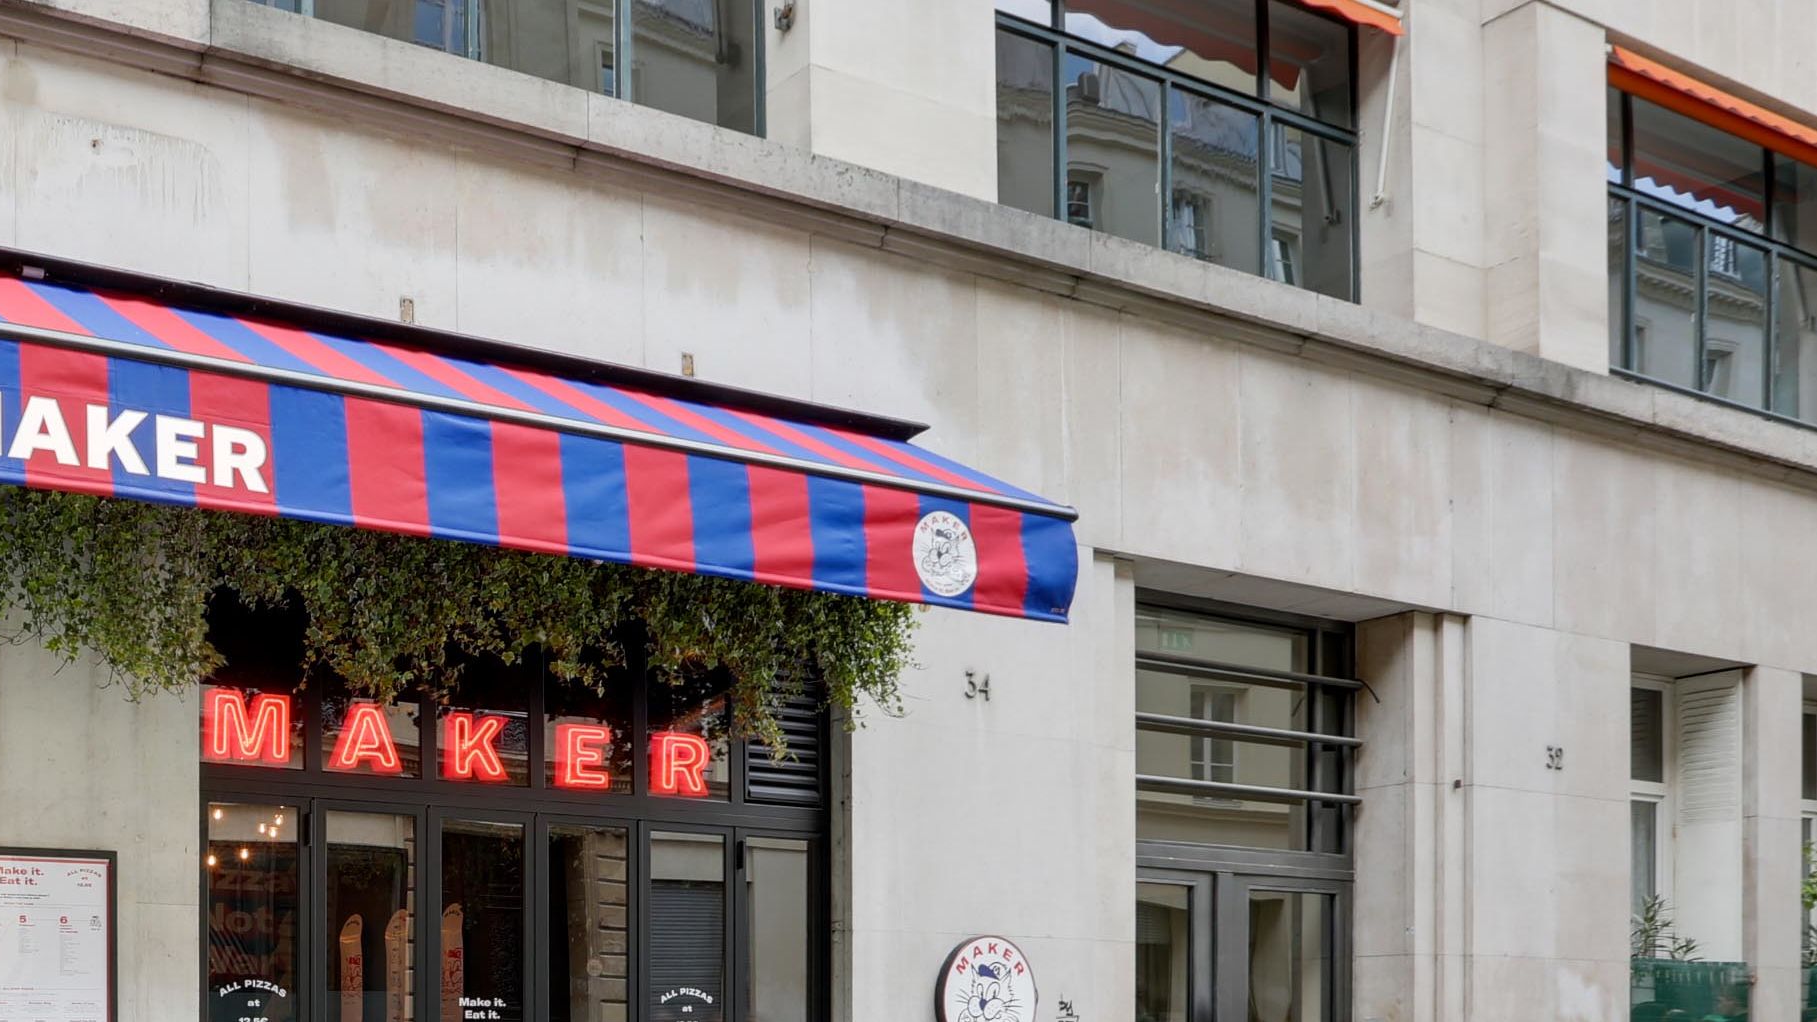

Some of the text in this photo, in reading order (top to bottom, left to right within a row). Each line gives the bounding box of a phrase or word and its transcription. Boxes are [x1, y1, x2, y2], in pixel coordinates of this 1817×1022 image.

[964, 670, 990, 701] 34
[204, 688, 710, 797] MAKER
[1546, 745, 1564, 770] 32
[31, 867, 44, 876] it.
[0, 877, 38, 886] Eat it.
[19, 915, 27, 923] 5
[59, 916, 68, 924] 6
[955, 942, 1025, 976] MAKER
[219, 979, 287, 998] ALL PIZZAS
[660, 987, 713, 1004] ALL PIZZAS
[247, 999, 261, 1007] at
[458, 997, 507, 1007] Make it.
[464, 1009, 501, 1019] Eat it.
[681, 1005, 693, 1013] at
